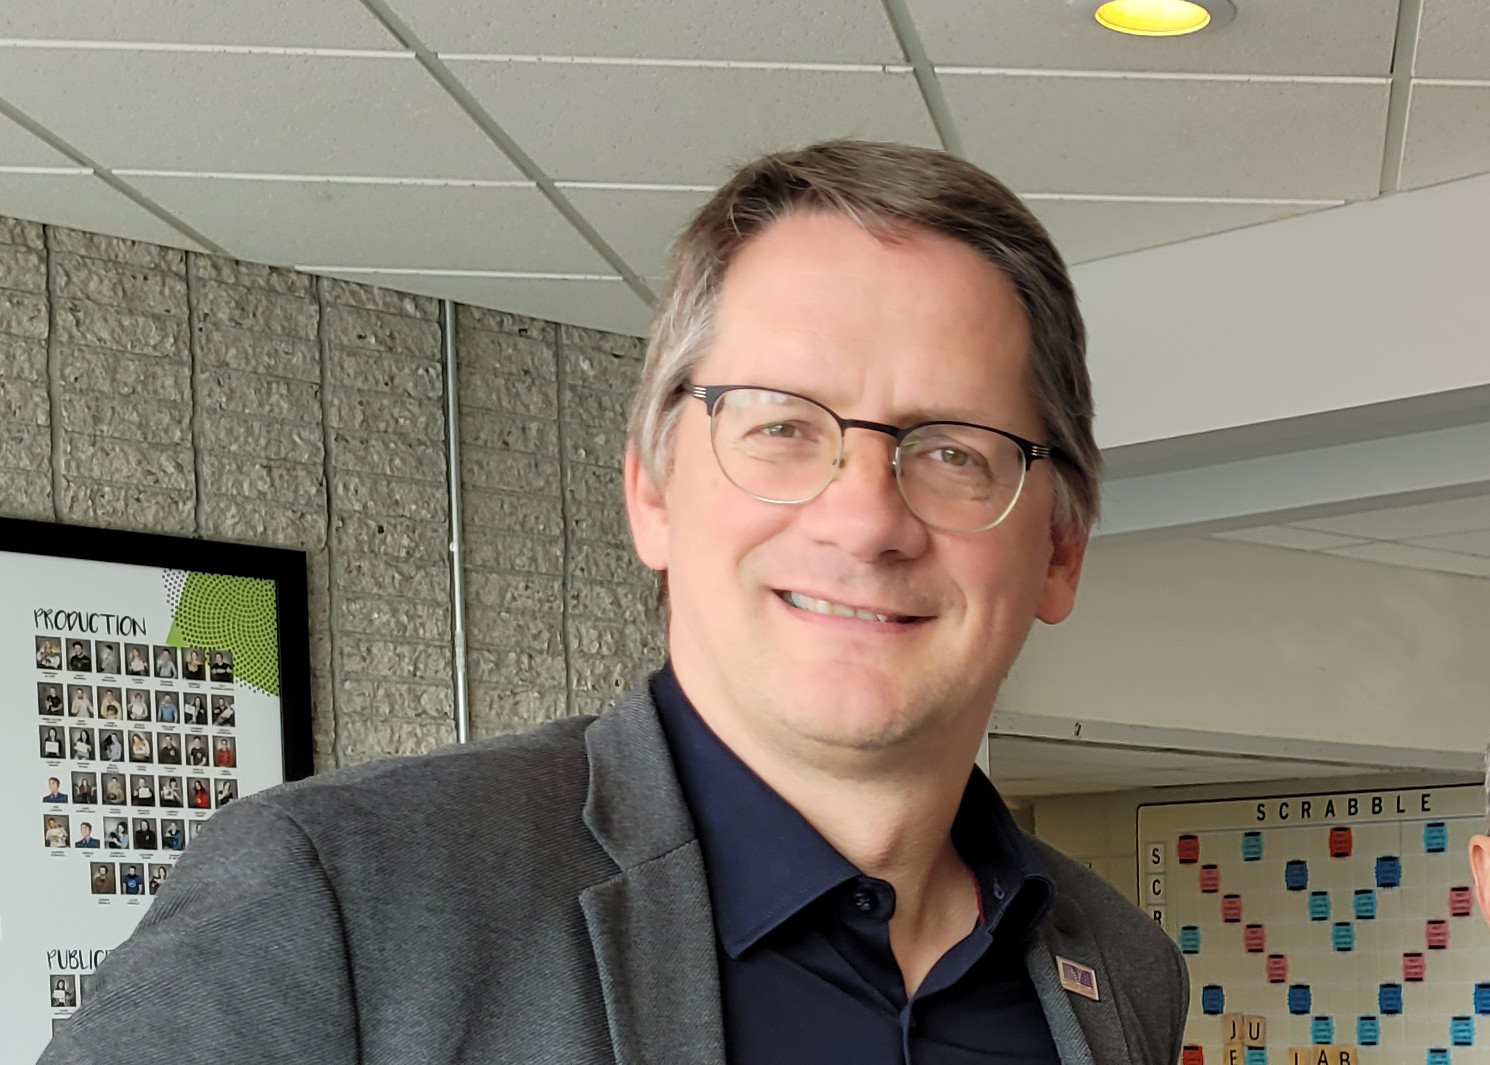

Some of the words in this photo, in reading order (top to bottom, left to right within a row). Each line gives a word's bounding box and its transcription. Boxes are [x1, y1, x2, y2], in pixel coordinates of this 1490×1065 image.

[33, 607, 147, 637] PRODUCTION
[1256, 793, 1431, 821] SCRABBLE
[46, 949, 114, 971] PUBLIC
